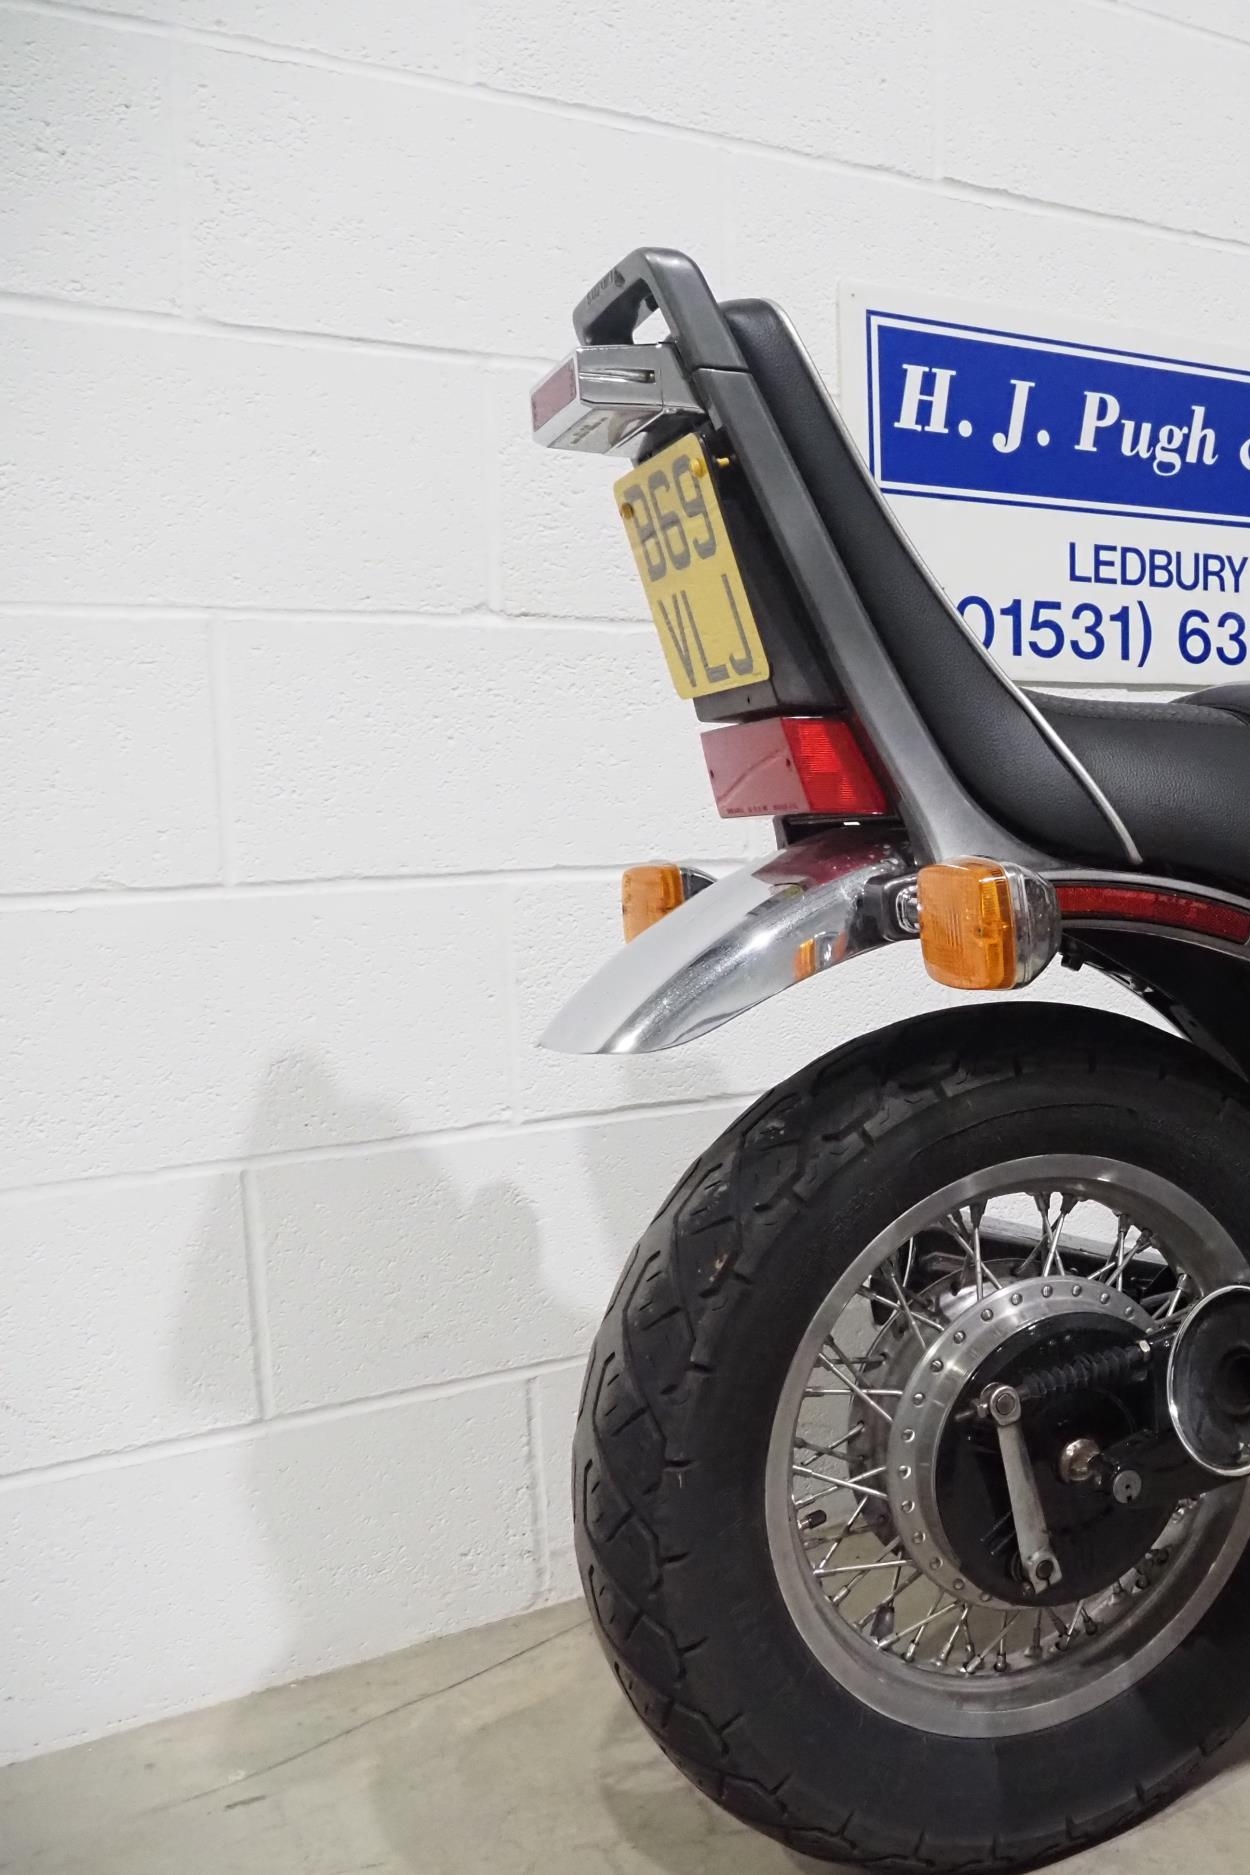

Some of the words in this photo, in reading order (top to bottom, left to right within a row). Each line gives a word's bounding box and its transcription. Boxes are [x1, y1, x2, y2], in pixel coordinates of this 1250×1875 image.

[894, 363, 973, 438] H.
[992, 379, 1050, 453] J.
[1074, 390, 1219, 477] Pugh
[623, 454, 717, 582] B69
[1069, 542, 1248, 593] LEDBURY
[658, 573, 754, 688] VLJ
[942, 587, 1153, 667] 01531)
